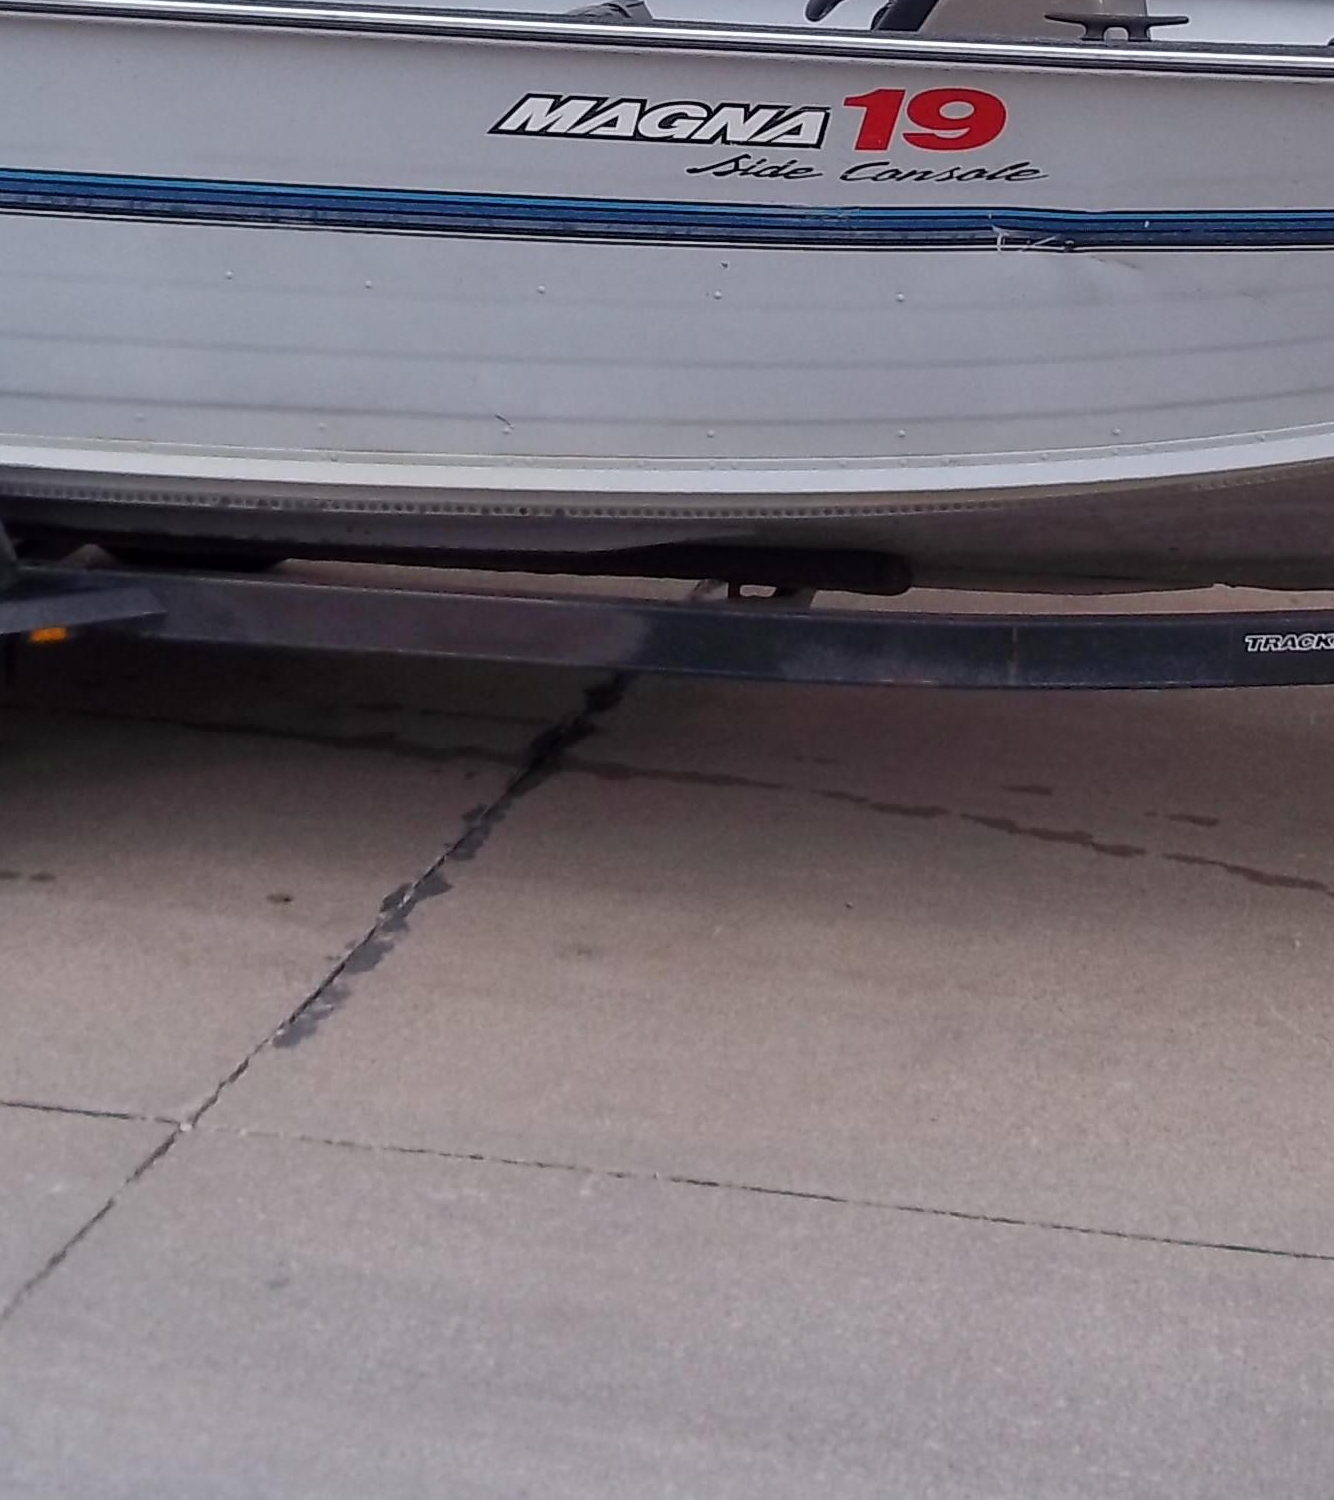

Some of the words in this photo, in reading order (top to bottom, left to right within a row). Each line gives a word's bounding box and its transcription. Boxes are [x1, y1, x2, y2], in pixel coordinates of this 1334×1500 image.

[488, 92, 831, 149] MAGNA
[843, 87, 1008, 152] 19
[685, 152, 824, 181] Side
[838, 160, 1049, 183] Console
